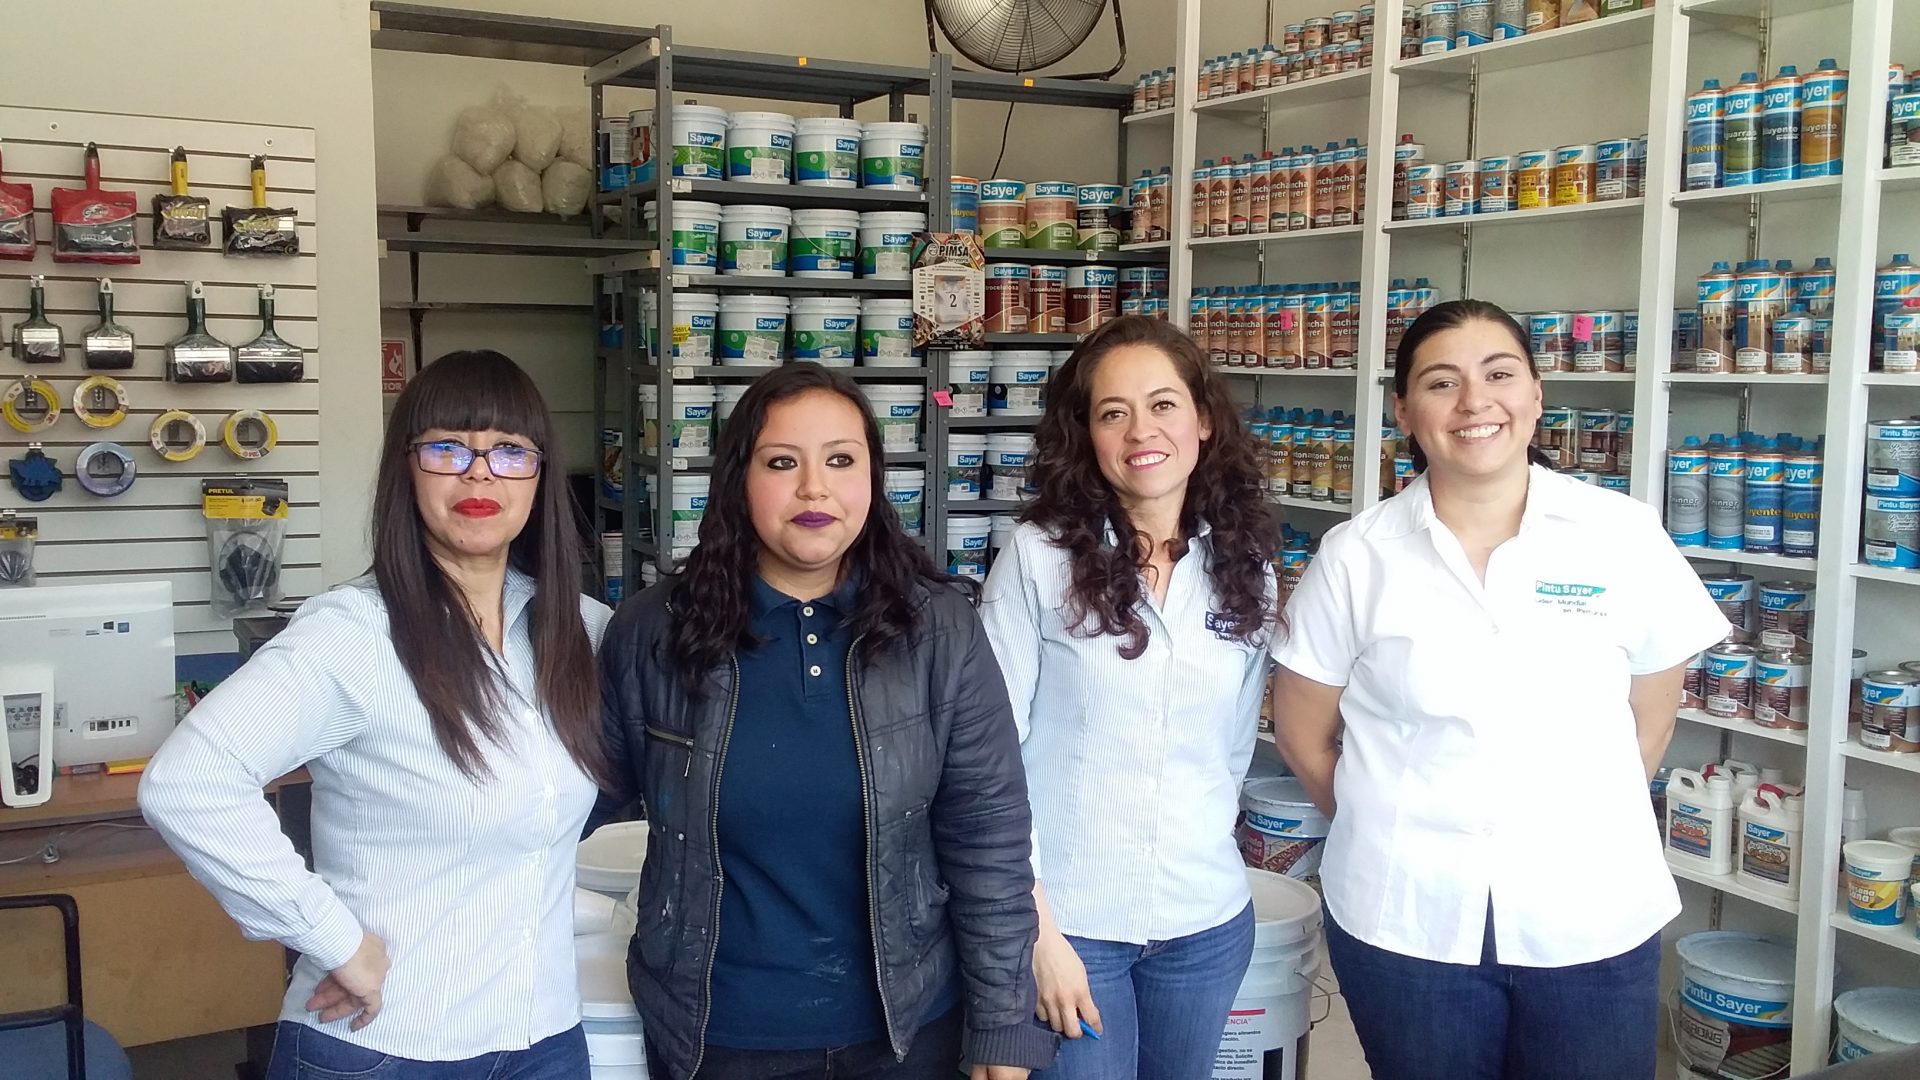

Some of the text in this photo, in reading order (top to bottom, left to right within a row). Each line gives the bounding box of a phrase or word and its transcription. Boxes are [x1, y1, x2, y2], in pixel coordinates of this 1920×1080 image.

[690, 133, 715, 145] Sayer
[902, 145, 921, 155] Sayer
[982, 184, 1017, 197] Sayer
[1036, 185, 1058, 194] Sayer
[1081, 189, 1114, 202] Sayer
[747, 229, 772, 239] Sayer
[884, 235, 908, 244] Sayer
[939, 245, 968, 256] PIMSA
[1043, 270, 1060, 278] Sayer
[1087, 271, 1116, 284] Sayer
[950, 294, 957, 307] 2
[758, 319, 779, 329] Sayer
[825, 320, 848, 329] Sayer
[900, 319, 912, 328] Say
[1018, 373, 1039, 381] Sayer
[686, 408, 708, 417] Sayer
[892, 407, 914, 416] Sayer
[959, 456, 978, 464] Sayer
[1002, 455, 1024, 463] Sayer
[692, 499, 706, 508] Say
[1563, 585, 1593, 594] Sayer
[1257, 815, 1284, 828] Sayer
[1748, 824, 1770, 837] Sayer
[1686, 981, 1761, 1013] Pintu Sayer
